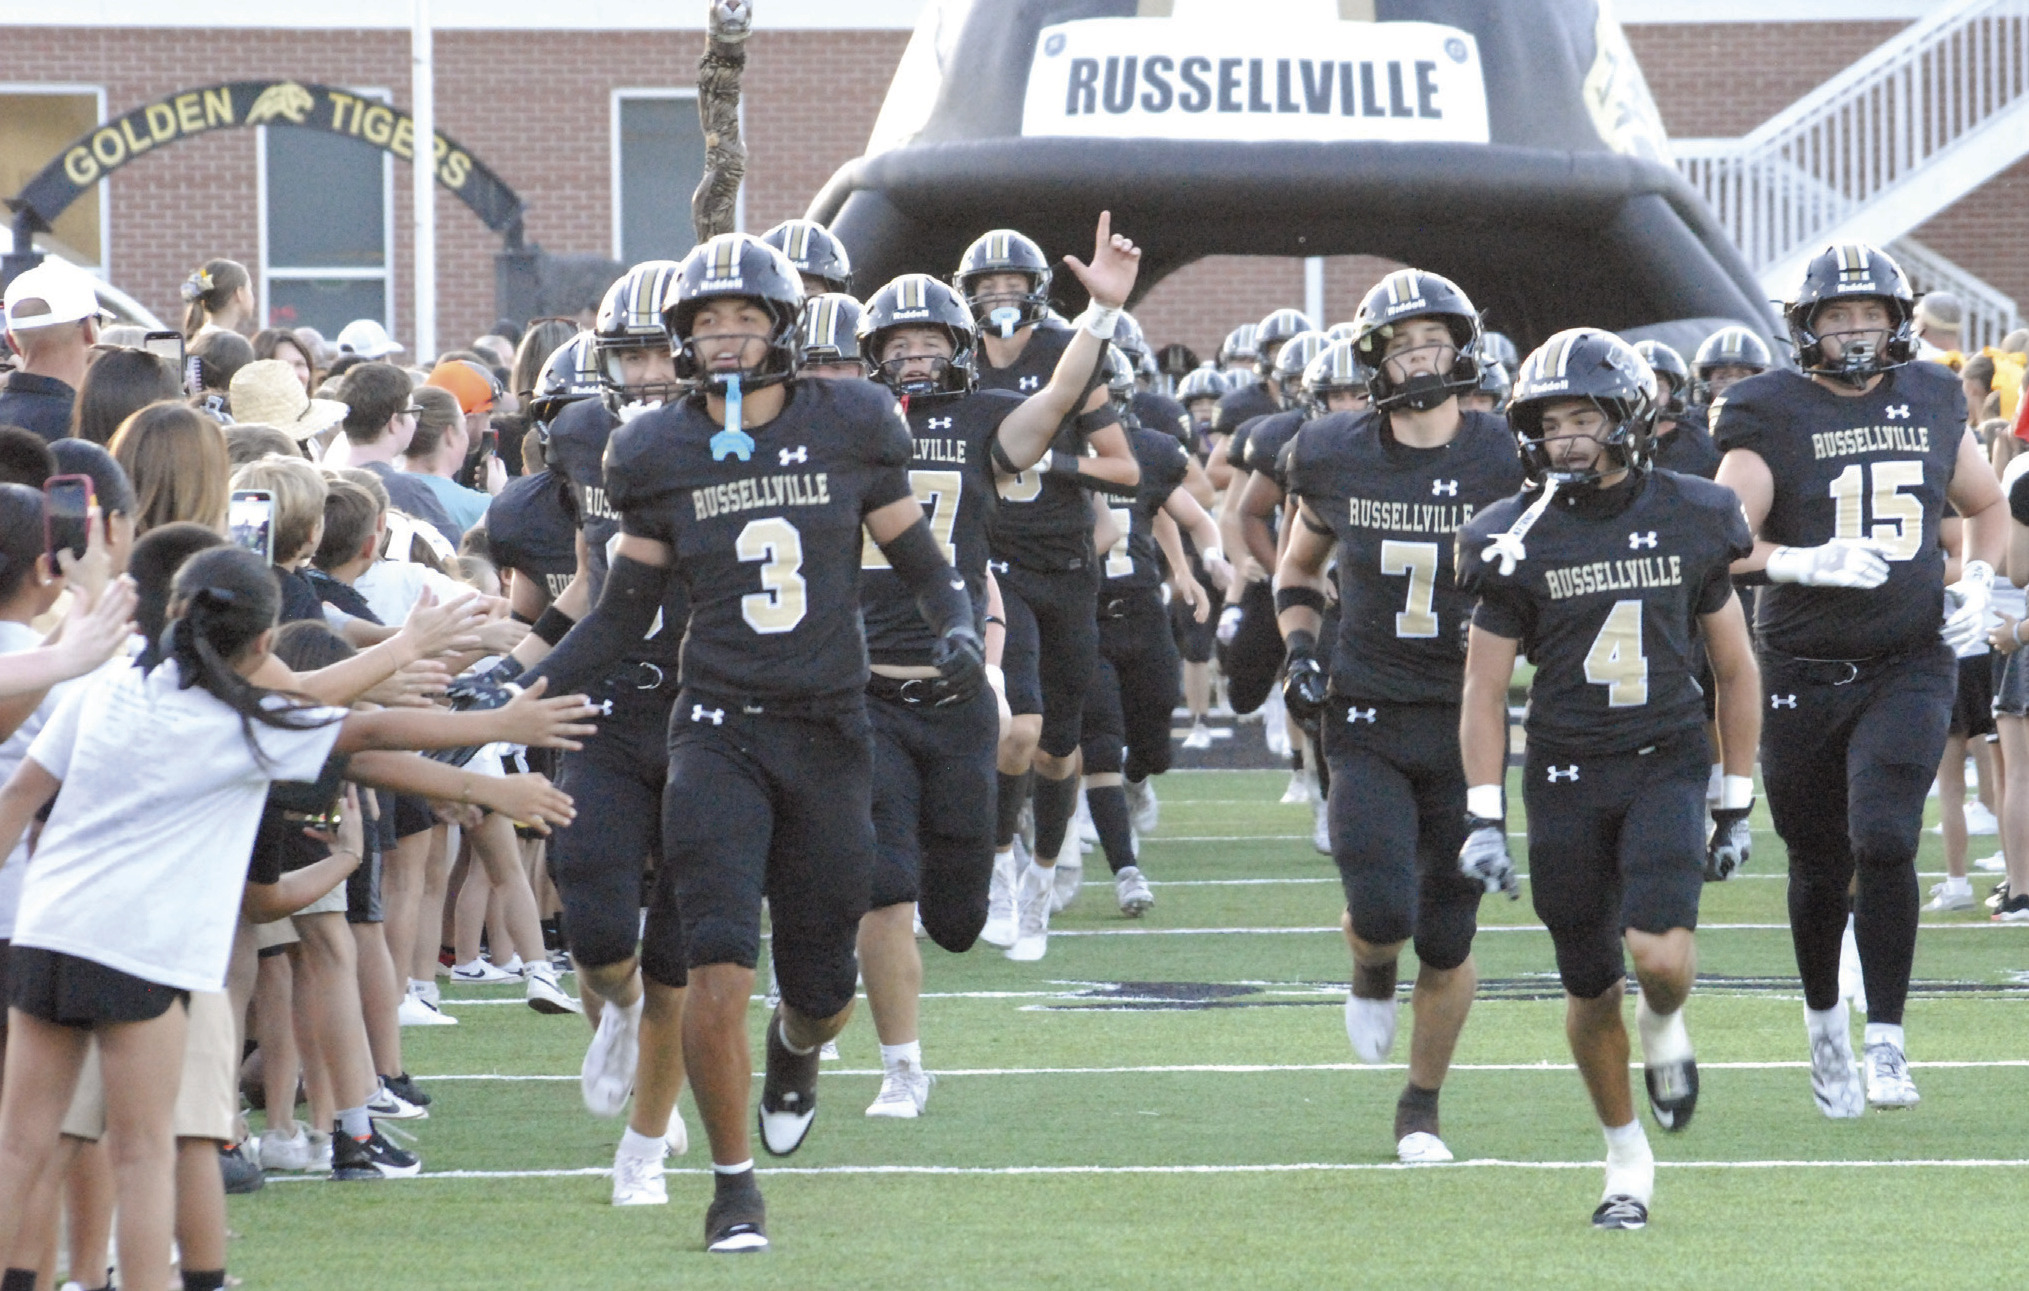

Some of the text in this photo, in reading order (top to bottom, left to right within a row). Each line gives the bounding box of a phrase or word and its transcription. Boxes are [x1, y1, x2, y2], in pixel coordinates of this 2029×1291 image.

[1065, 55, 1443, 119] RUSSELLVILLE
[64, 87, 235, 186] GOLDEN
[892, 309, 930, 320] Riddell
[1530, 379, 1569, 394] Riddell
[1811, 425, 1930, 460] RUSSELLVILLE
[692, 472, 831, 521] RUSSELLVILLE
[1829, 460, 1924, 561] 15
[735, 516, 808, 635] 3
[1380, 539, 1439, 638] 7
[1545, 555, 1683, 600] RUSSELLVILLE
[1583, 599, 1648, 708] 4
